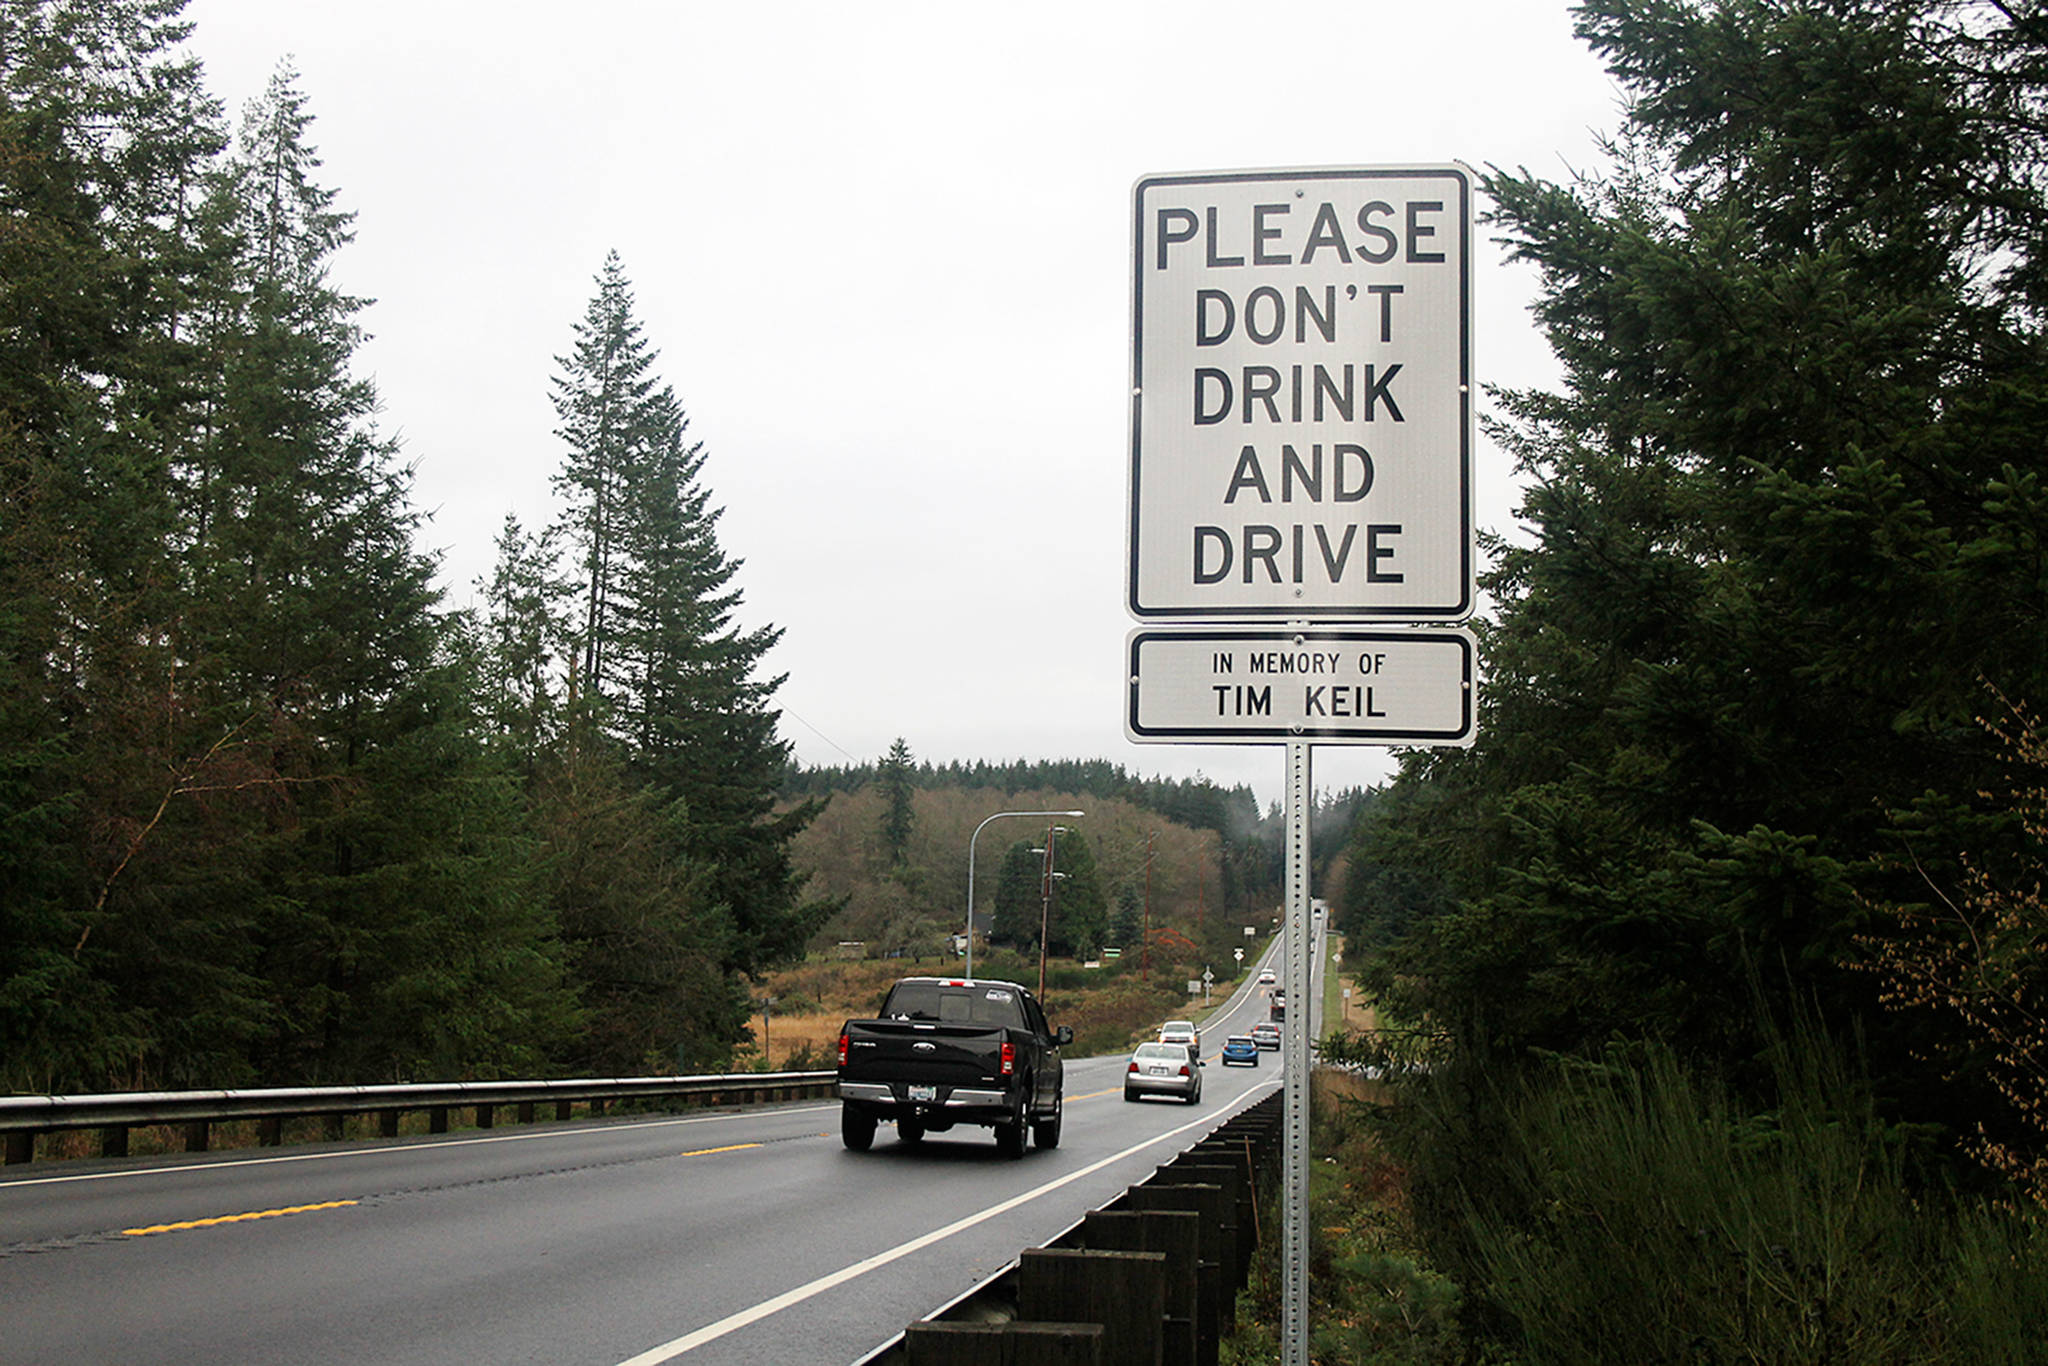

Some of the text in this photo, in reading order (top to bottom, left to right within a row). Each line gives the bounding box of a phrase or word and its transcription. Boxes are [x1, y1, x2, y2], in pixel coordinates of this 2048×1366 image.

[1157, 201, 1447, 270] PLEASE
[1196, 284, 1405, 347] DON'T
[1193, 363, 1406, 426] DRINK
[1223, 444, 1375, 504] AND
[1193, 524, 1404, 585] DRIVE
[1212, 652, 1387, 675] IN MEMORY OF
[1212, 685, 1387, 718] TIM KEIL
